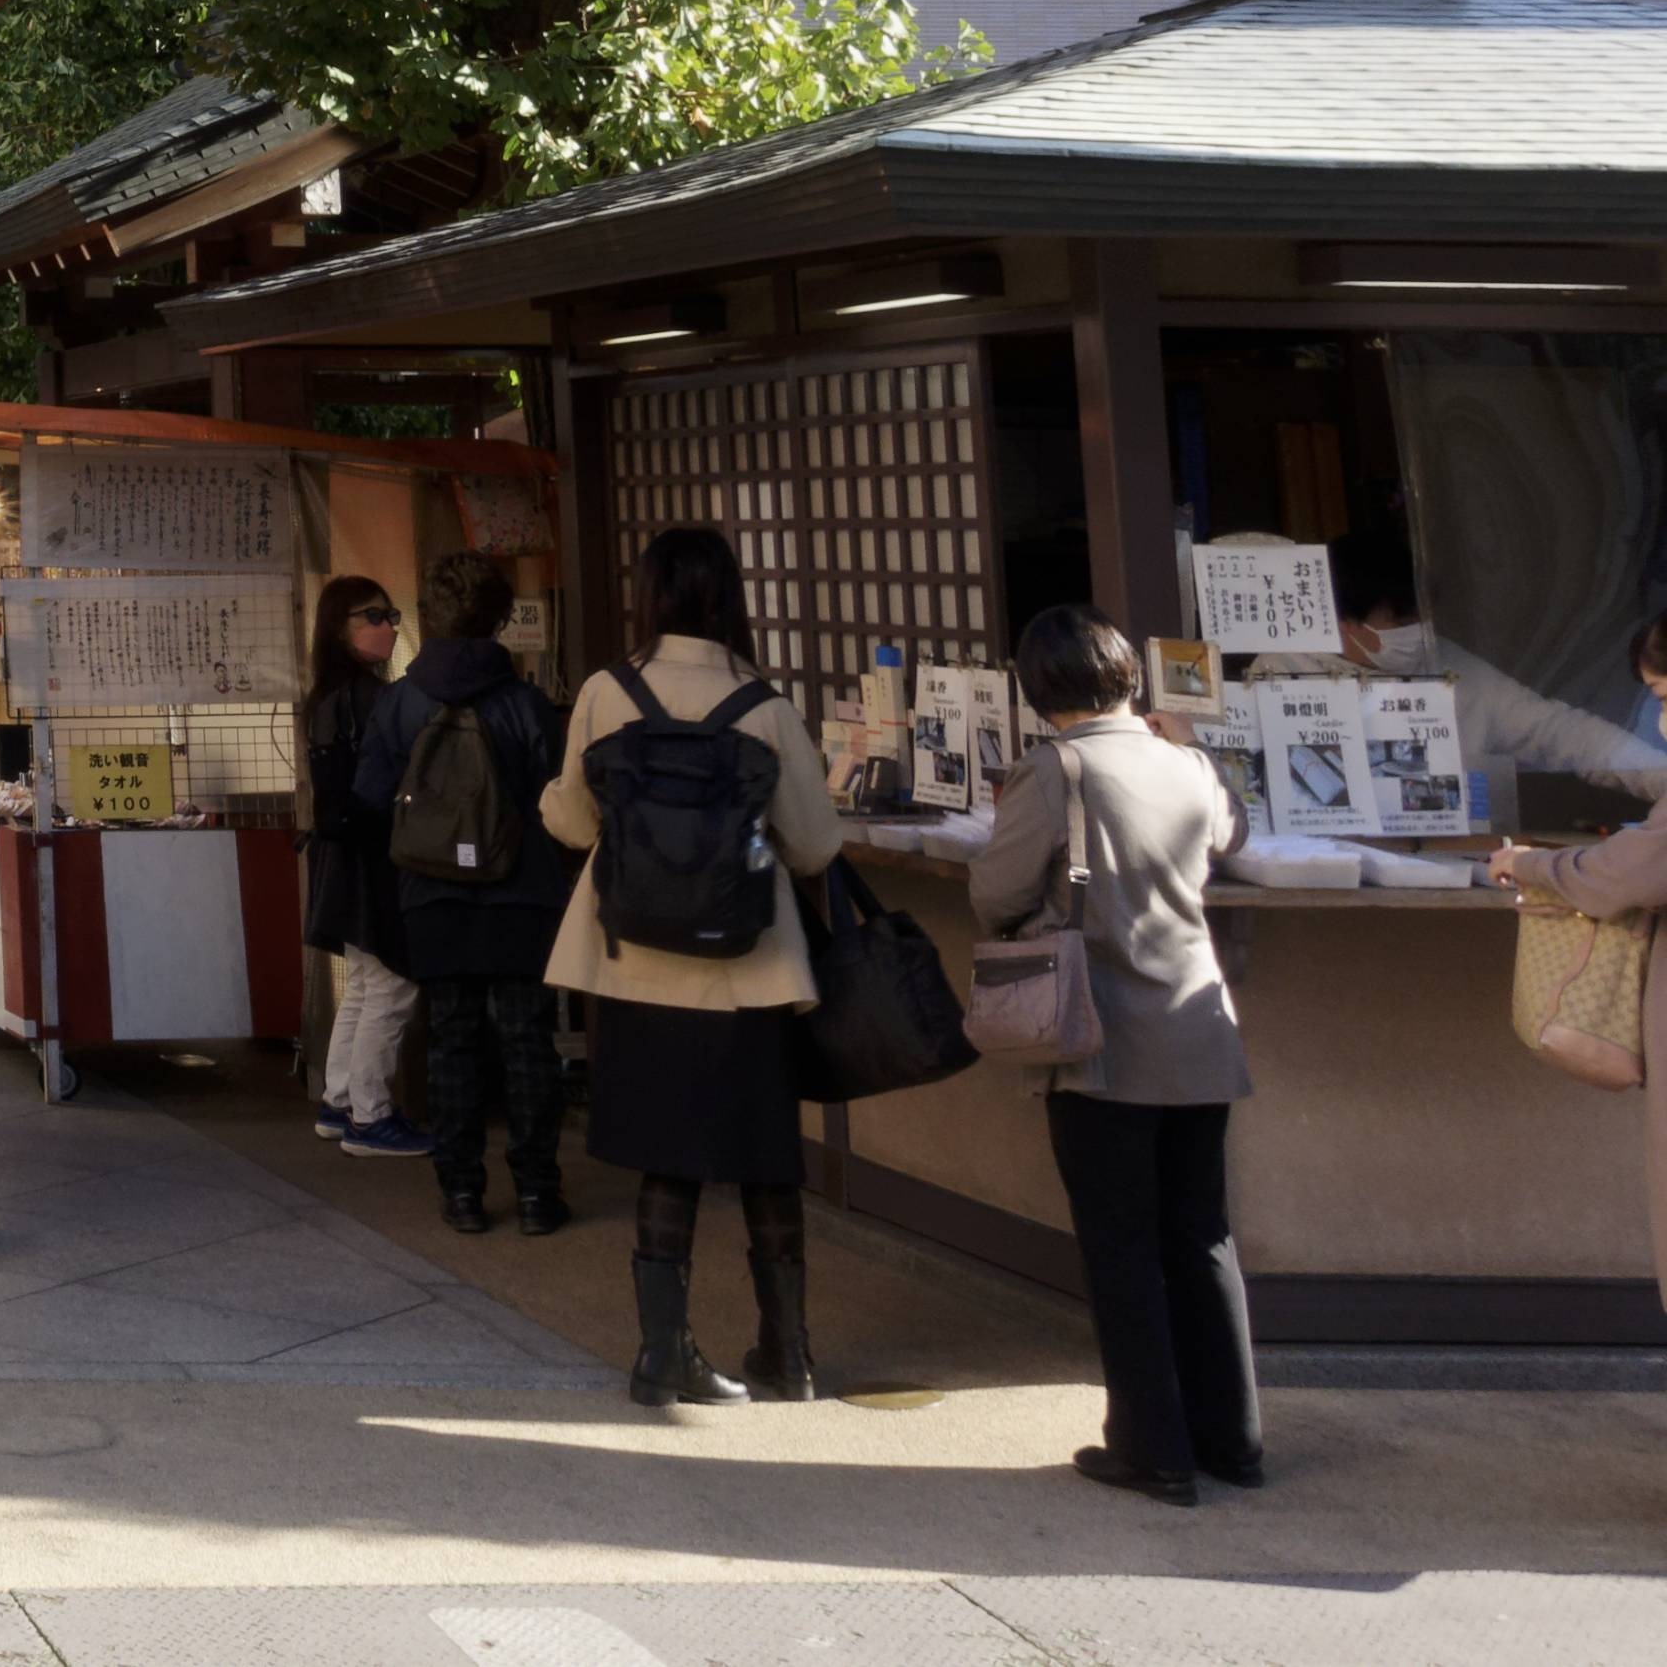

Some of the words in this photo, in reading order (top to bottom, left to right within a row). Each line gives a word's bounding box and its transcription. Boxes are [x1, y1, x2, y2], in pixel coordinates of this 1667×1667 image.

[1293, 561, 1315, 630] おまいり
[1263, 575, 1278, 639] ¥400
[1278, 591, 1297, 637] セット
[1380, 698, 1427, 712] お線香
[934, 705, 962, 721] ¥100
[1204, 732, 1246, 747] ¥100
[1409, 726, 1450, 740] ¥100
[89, 752, 149, 768] 洗い観音
[99, 774, 143, 789] タオル
[93, 796, 150, 811] ¥100
